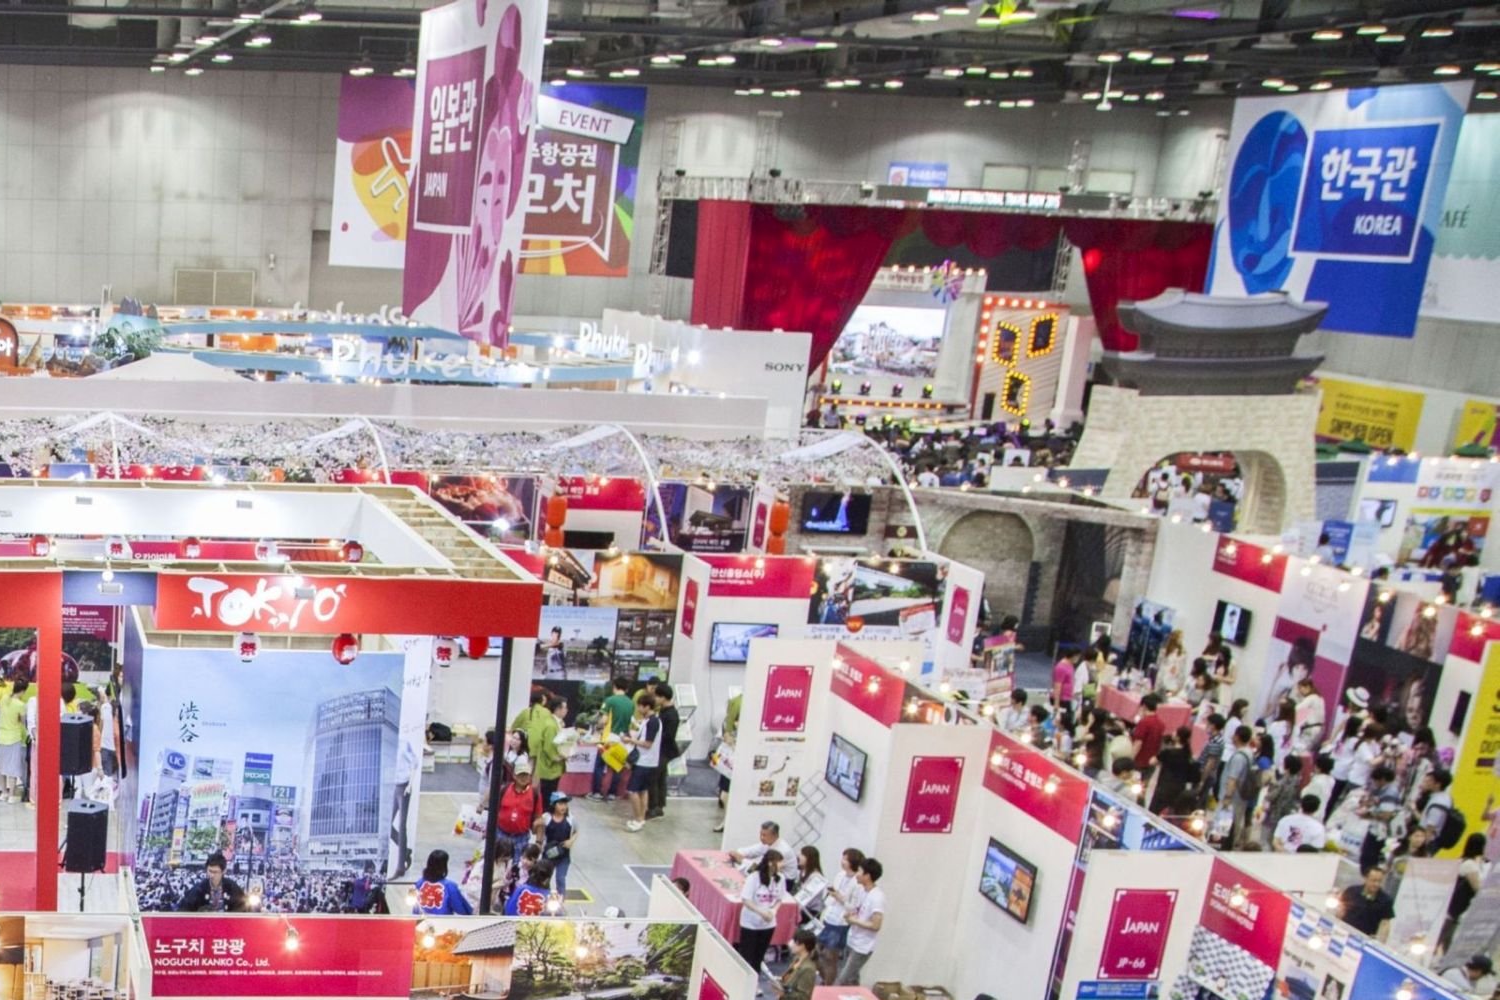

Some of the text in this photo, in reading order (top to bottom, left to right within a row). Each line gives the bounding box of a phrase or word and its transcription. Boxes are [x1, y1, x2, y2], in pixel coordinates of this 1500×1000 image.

[429, 79, 478, 155] 일본관
[559, 110, 612, 134] EVENT
[1321, 147, 1417, 201] 한국관
[423, 172, 448, 198] JAPAN
[1352, 214, 1403, 235] KOREA
[764, 362, 805, 372] SONY
[186, 576, 347, 631] TOKYO
[773, 685, 803, 699] JAPAN
[177, 700, 201, 744] 渋谷
[772, 713, 795, 725] JP-64
[918, 780, 951, 796] JAPAN
[916, 812, 942, 825] JP-65
[1212, 882, 1240, 908] 도미
[1120, 917, 1160, 935] JAPAN
[153, 938, 245, 955] 노구치 관광
[154, 957, 270, 969] NOGUCHI KANKO Co., Ltd.
[1115, 957, 1146, 970] JP-66
